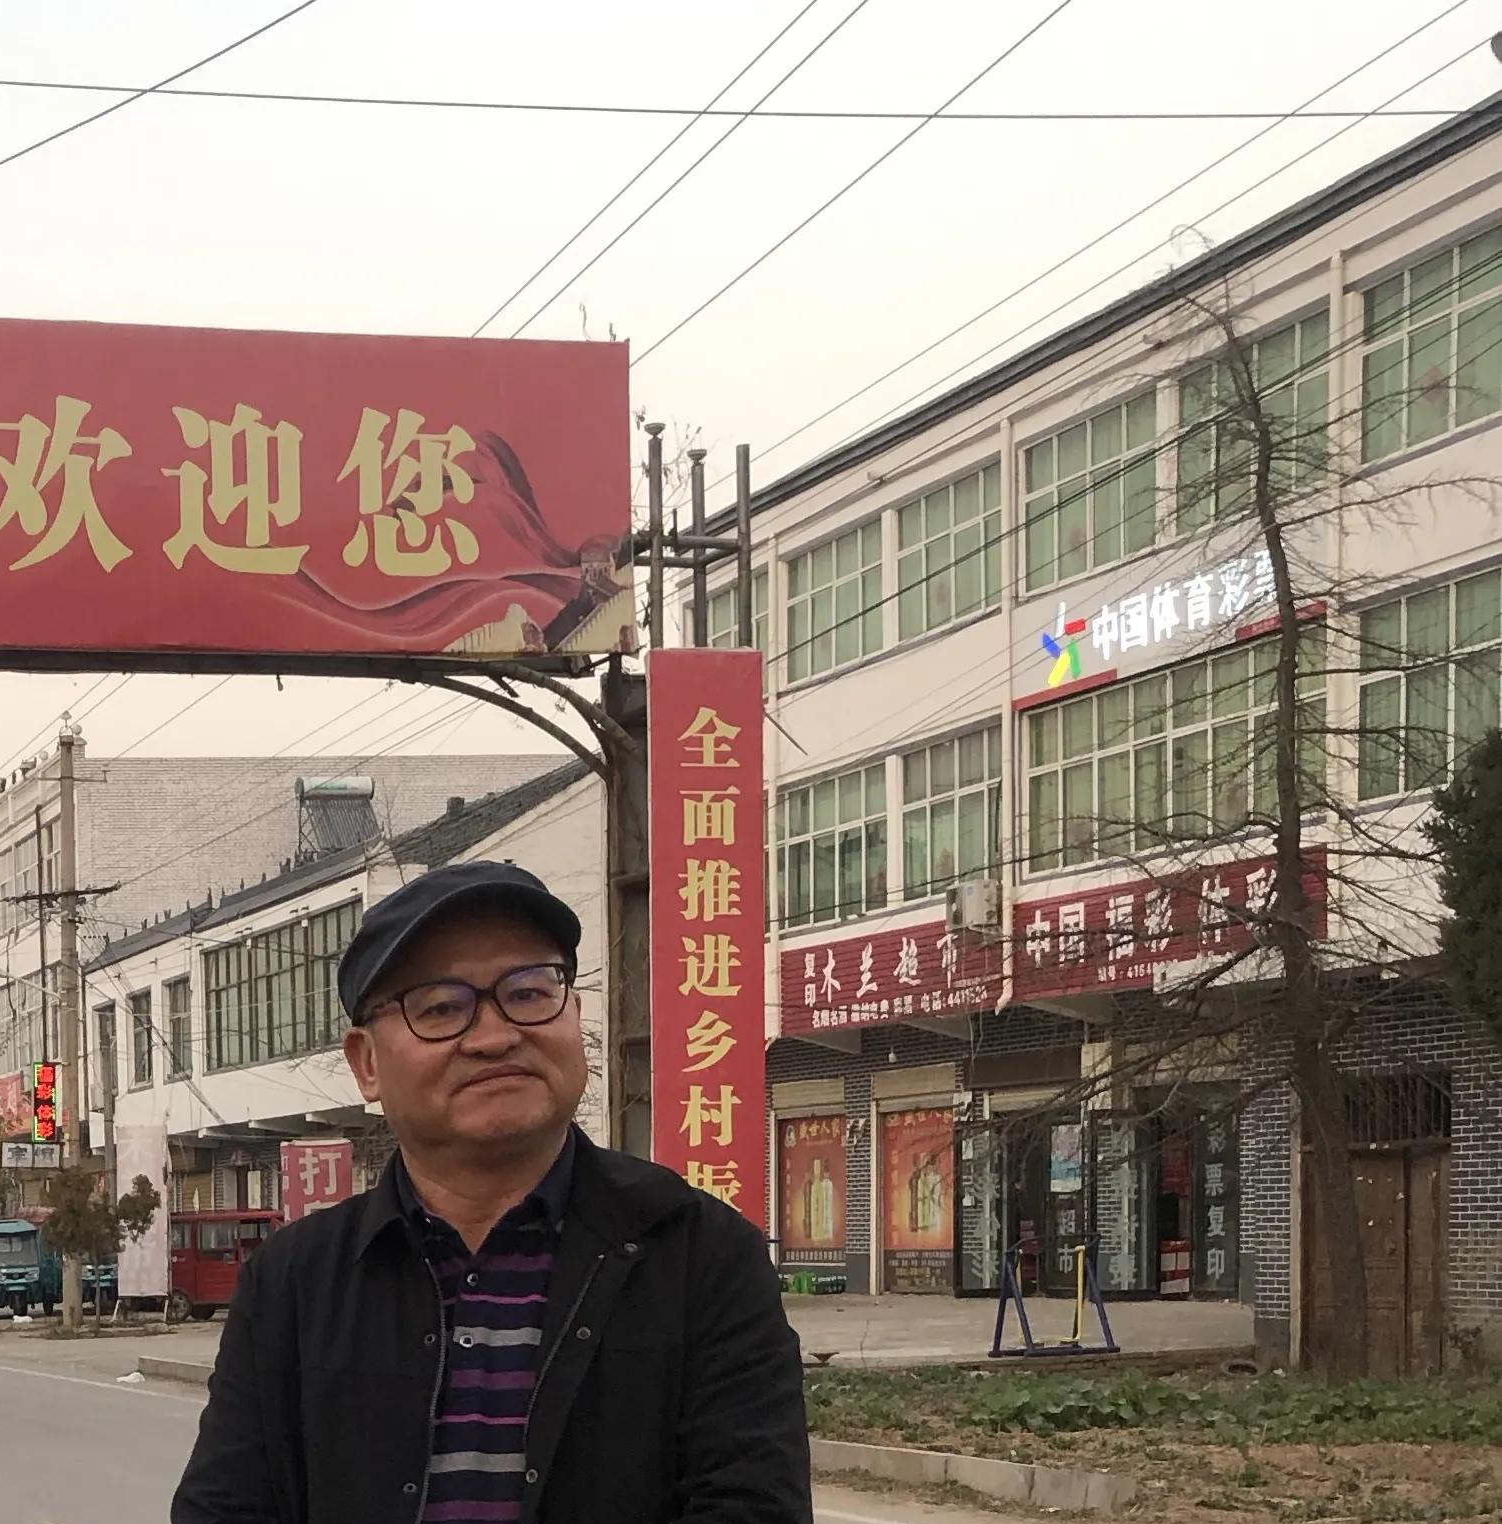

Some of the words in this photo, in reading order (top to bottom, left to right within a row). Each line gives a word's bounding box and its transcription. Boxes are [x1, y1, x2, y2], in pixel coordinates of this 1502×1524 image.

[804, 953, 816, 1007] 复印
[820, 933, 958, 1003] 木兰超市
